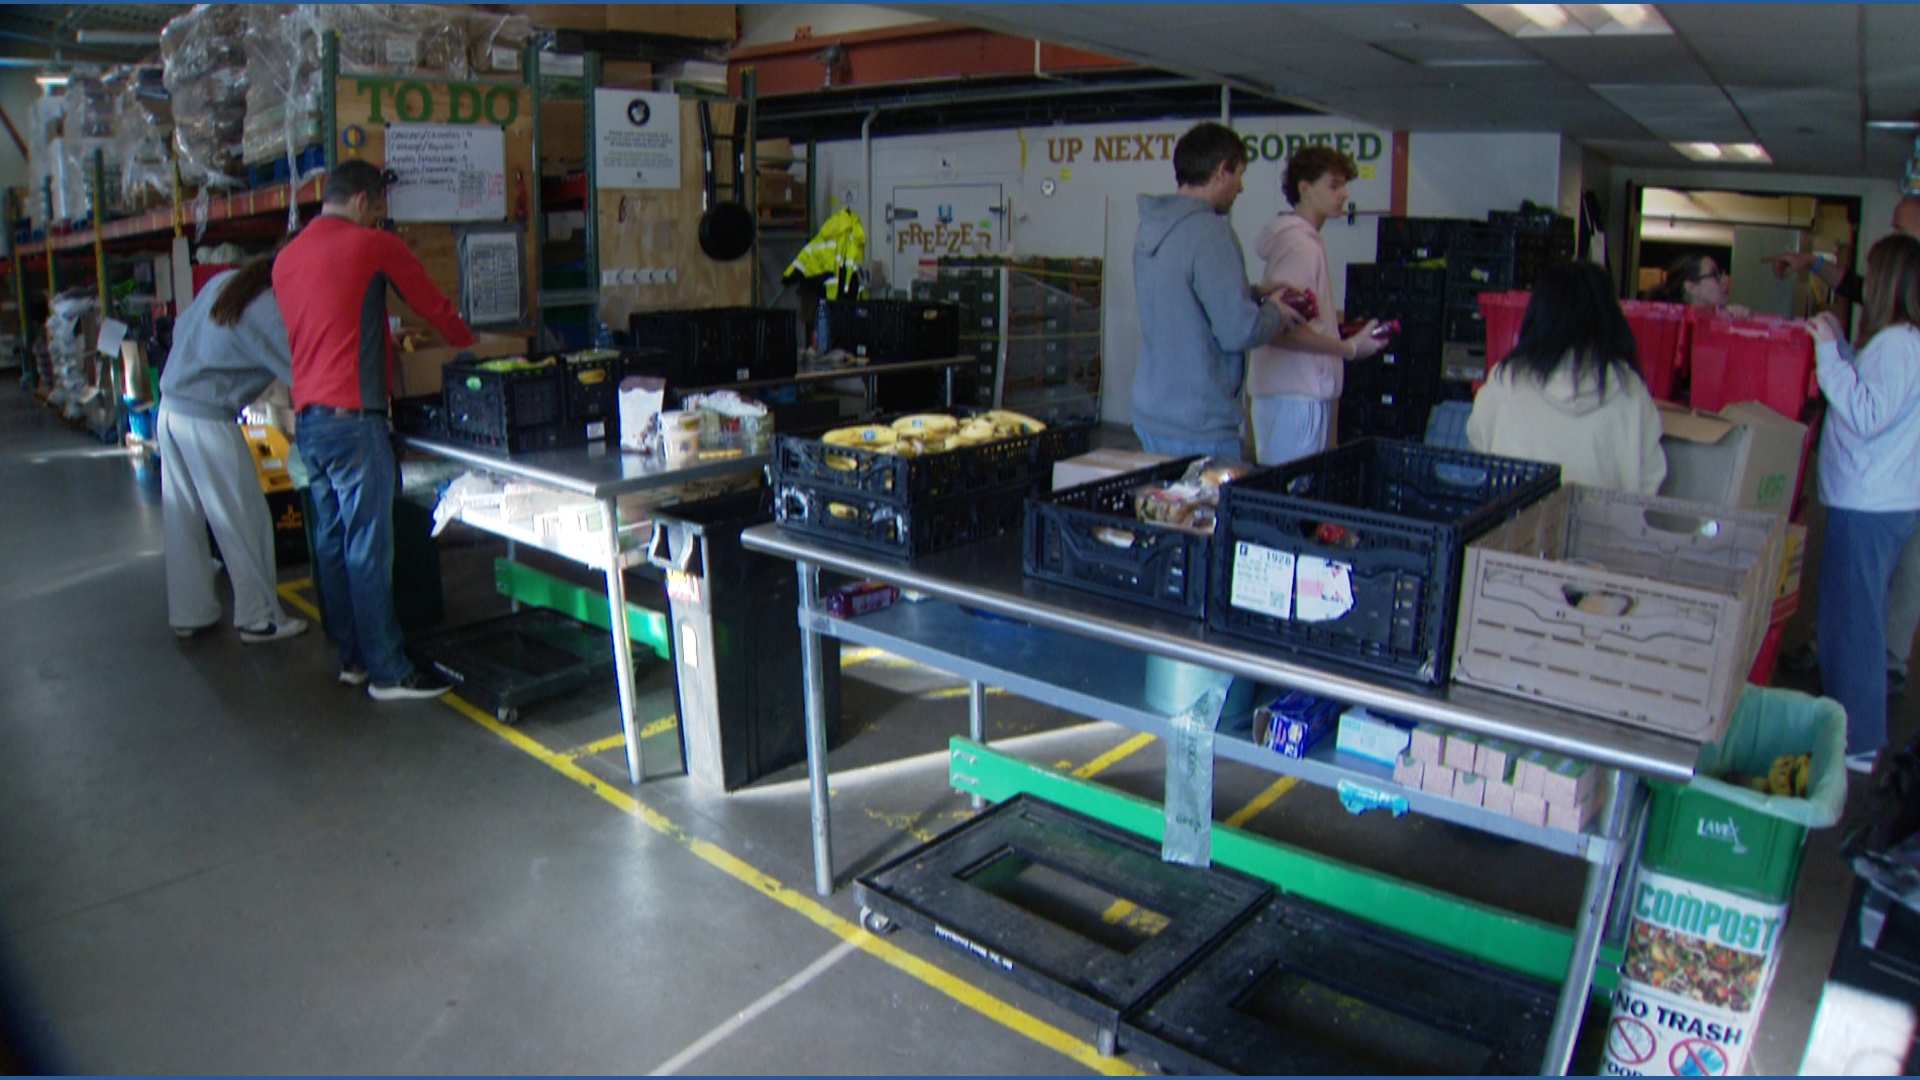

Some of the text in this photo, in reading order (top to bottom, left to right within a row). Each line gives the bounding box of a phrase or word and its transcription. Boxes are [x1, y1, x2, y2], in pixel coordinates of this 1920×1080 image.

[357, 79, 518, 126] TO DO
[1047, 132, 1176, 164] UP NEXT
[1241, 131, 1383, 162] SORTED
[1636, 881, 1780, 952] COMPOST
[1615, 988, 1743, 1045] NO TRASH
